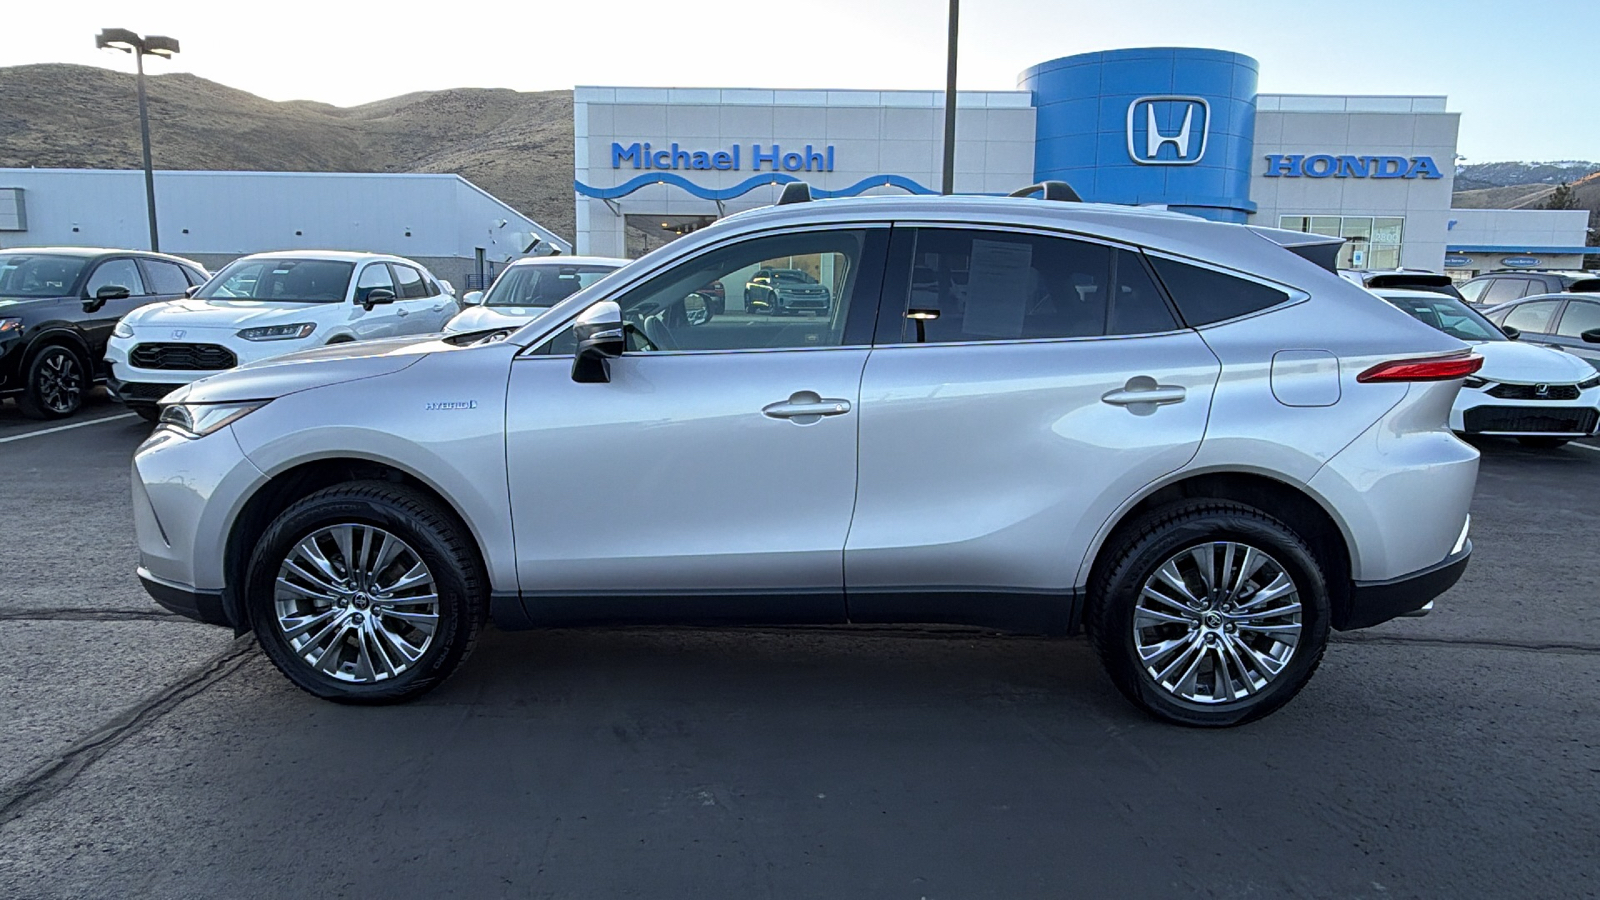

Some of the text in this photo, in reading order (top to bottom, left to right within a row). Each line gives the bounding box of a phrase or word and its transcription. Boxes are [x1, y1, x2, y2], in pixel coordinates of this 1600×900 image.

[611, 142, 835, 172] Michael Hohl
[1264, 153, 1444, 180] HONDA
